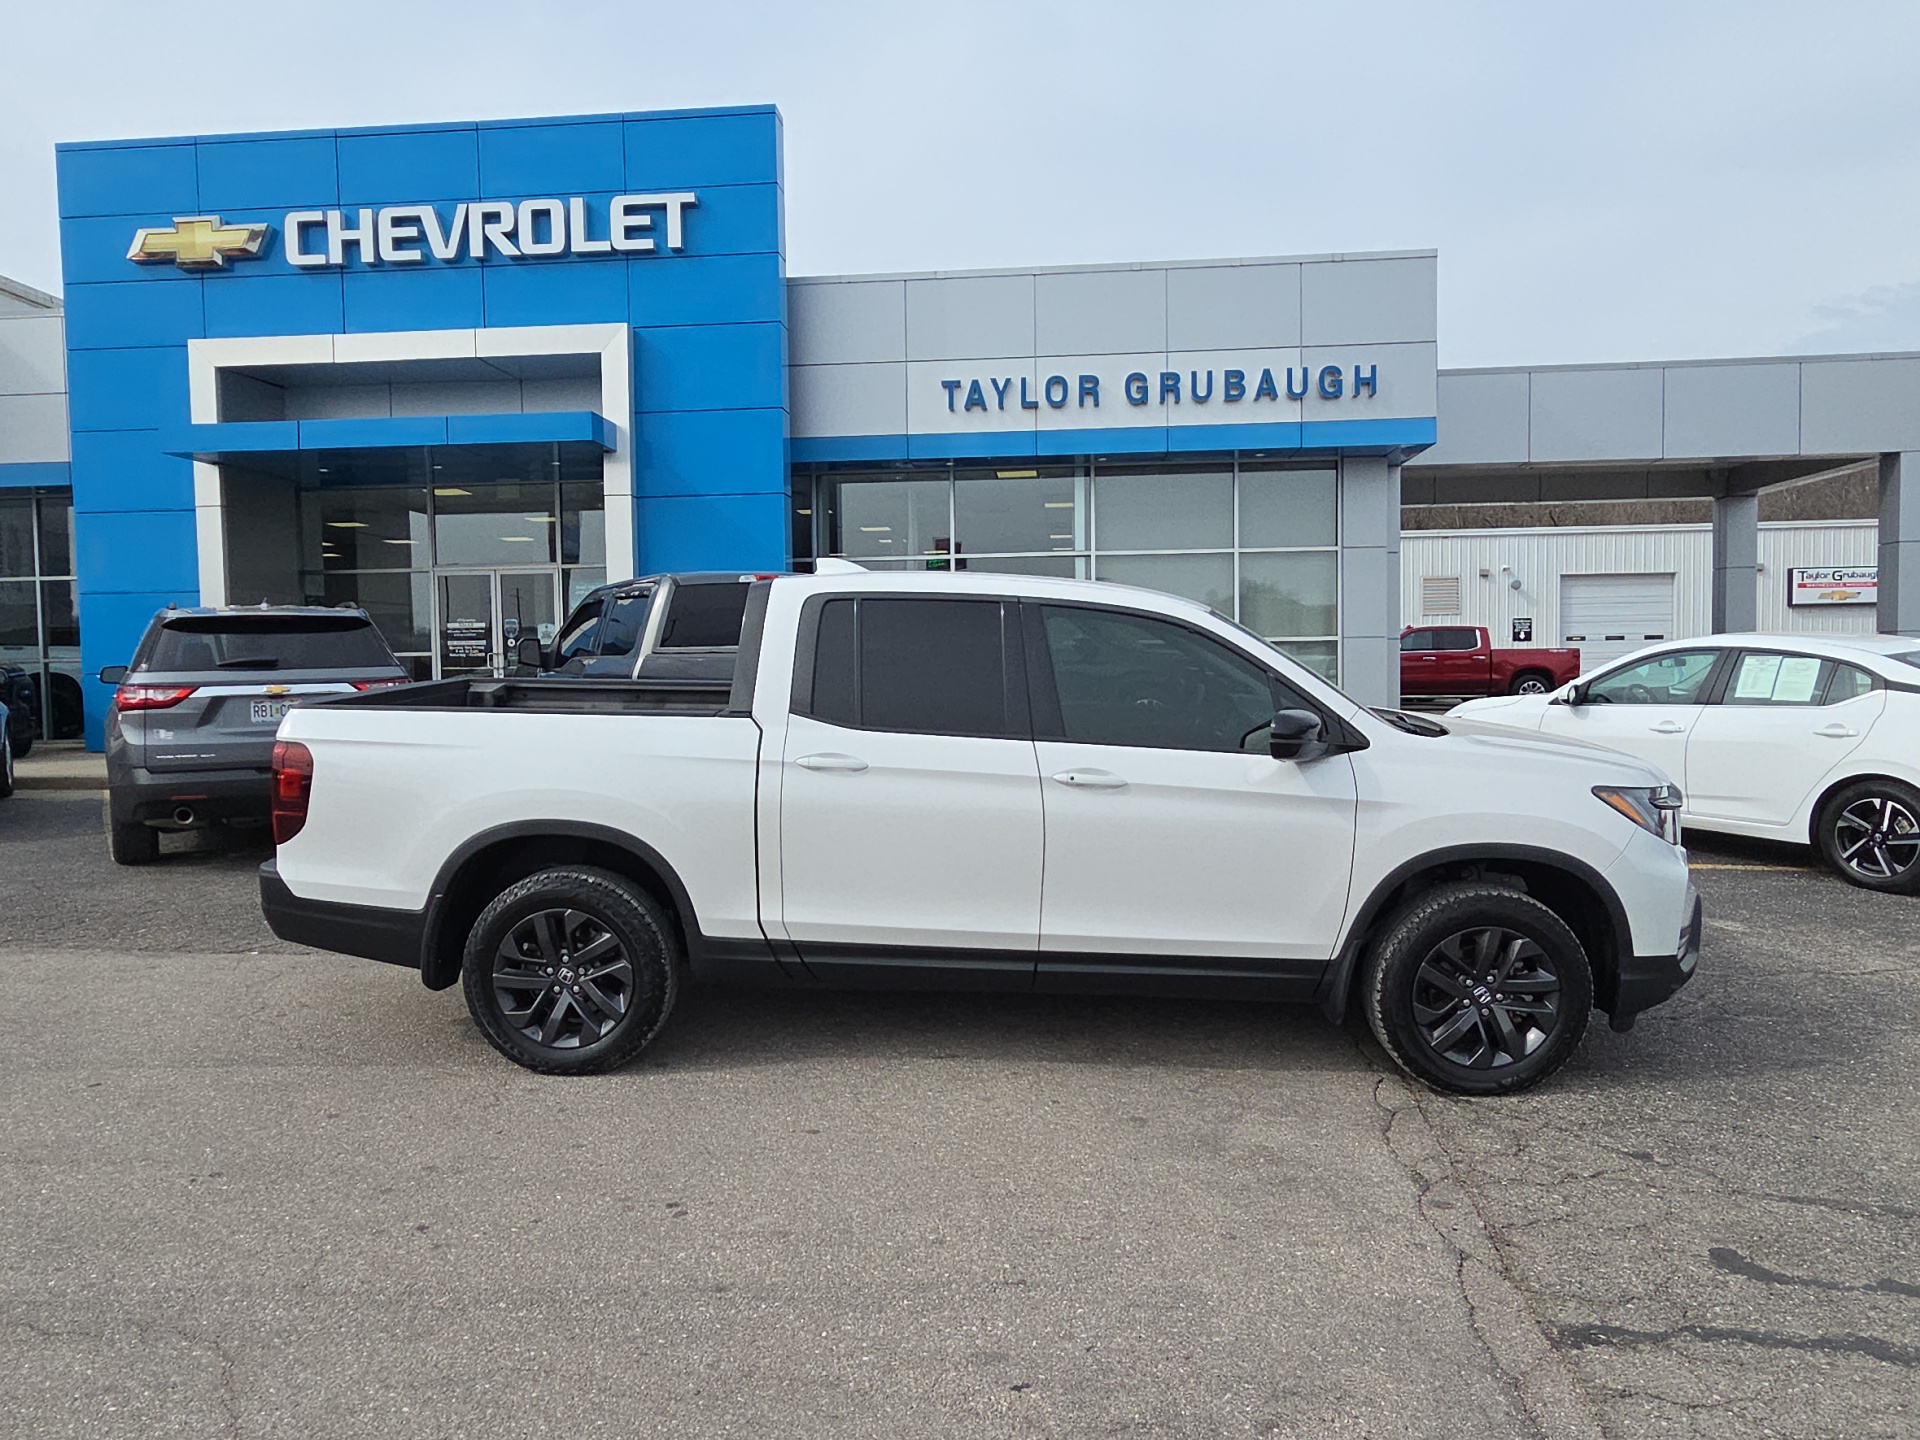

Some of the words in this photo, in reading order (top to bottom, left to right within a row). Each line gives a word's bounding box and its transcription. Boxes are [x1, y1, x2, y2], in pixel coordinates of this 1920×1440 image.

[284, 192, 697, 267] CHEVROLET
[941, 374, 1100, 411] TAYLOR
[1124, 364, 1378, 406] GRUBAUGH
[1797, 571, 1830, 582] Taylor
[1832, 570, 1878, 581] Grubaug
